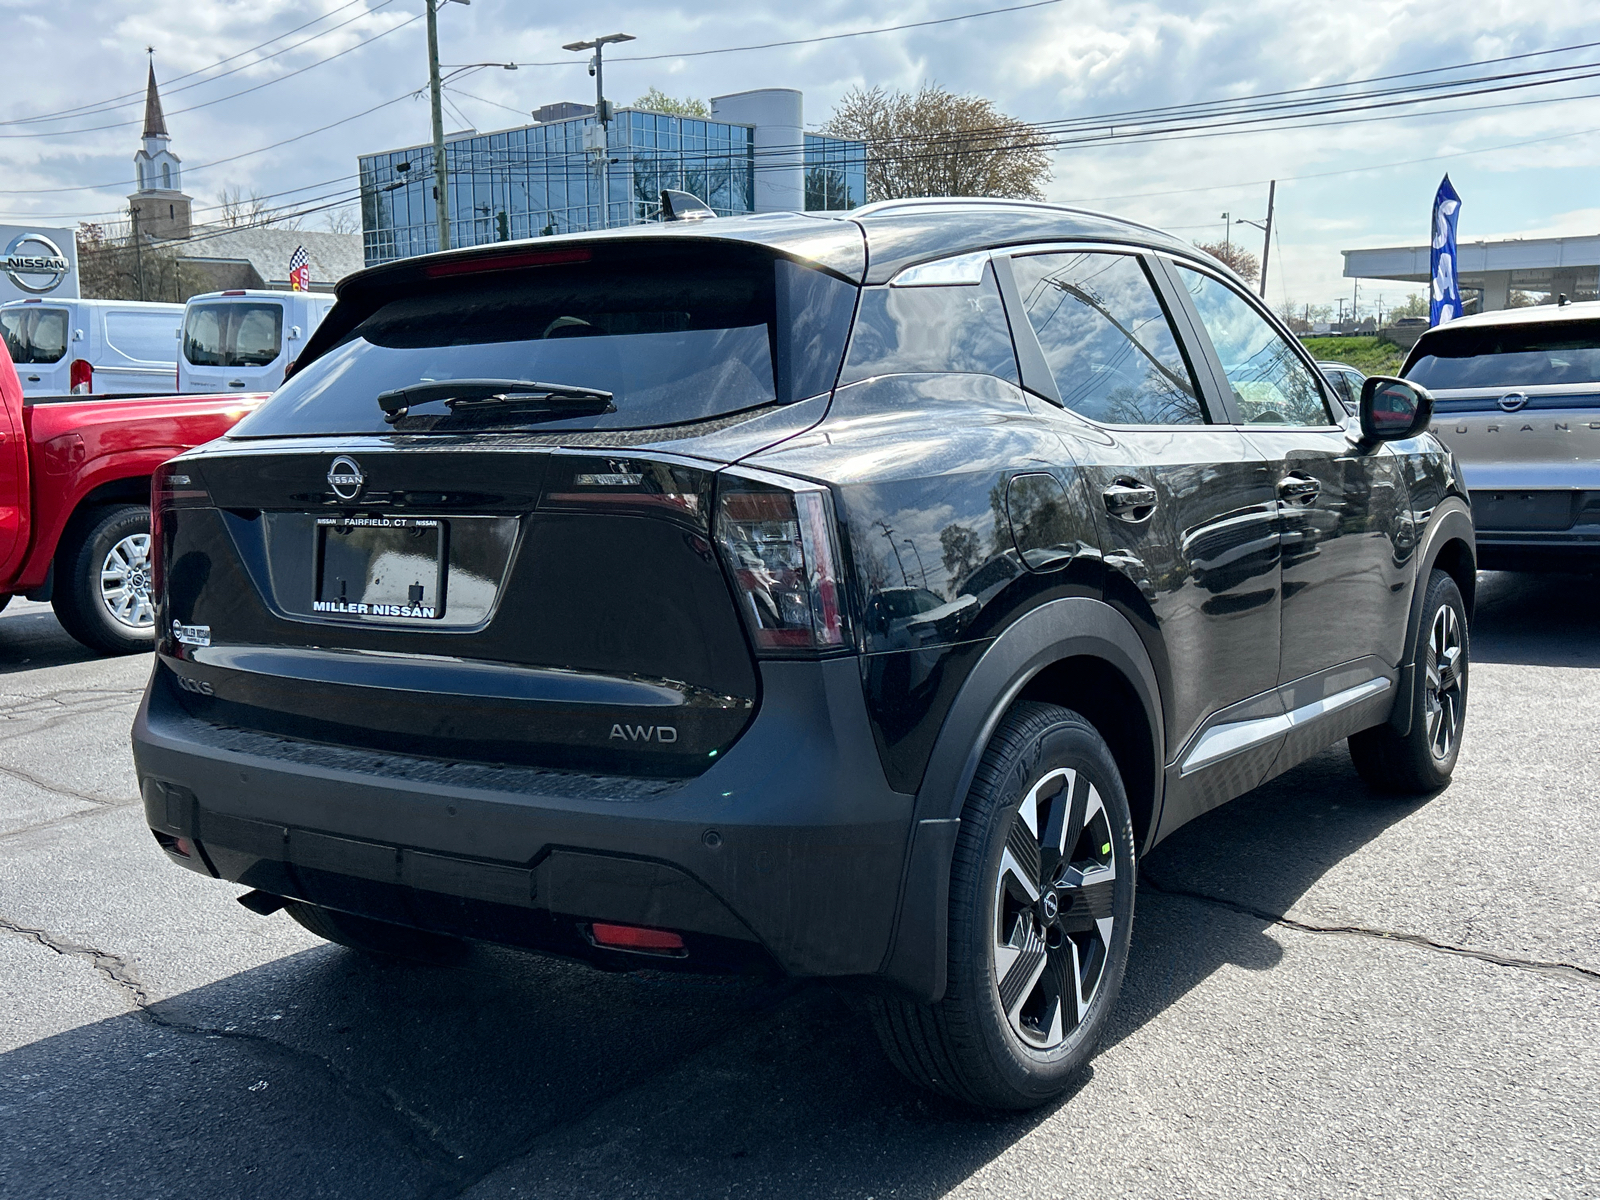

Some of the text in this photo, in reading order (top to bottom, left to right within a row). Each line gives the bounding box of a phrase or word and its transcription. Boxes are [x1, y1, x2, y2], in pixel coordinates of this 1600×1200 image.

[7, 257, 65, 269] NISSAN
[327, 475, 363, 484] NISSAN
[344, 518, 392, 528] FAIRFIELD,
[394, 519, 408, 527] CT
[415, 519, 438, 527] NISSAN
[313, 601, 435, 618] MILLER NISSAN
[608, 723, 678, 743] AWD
